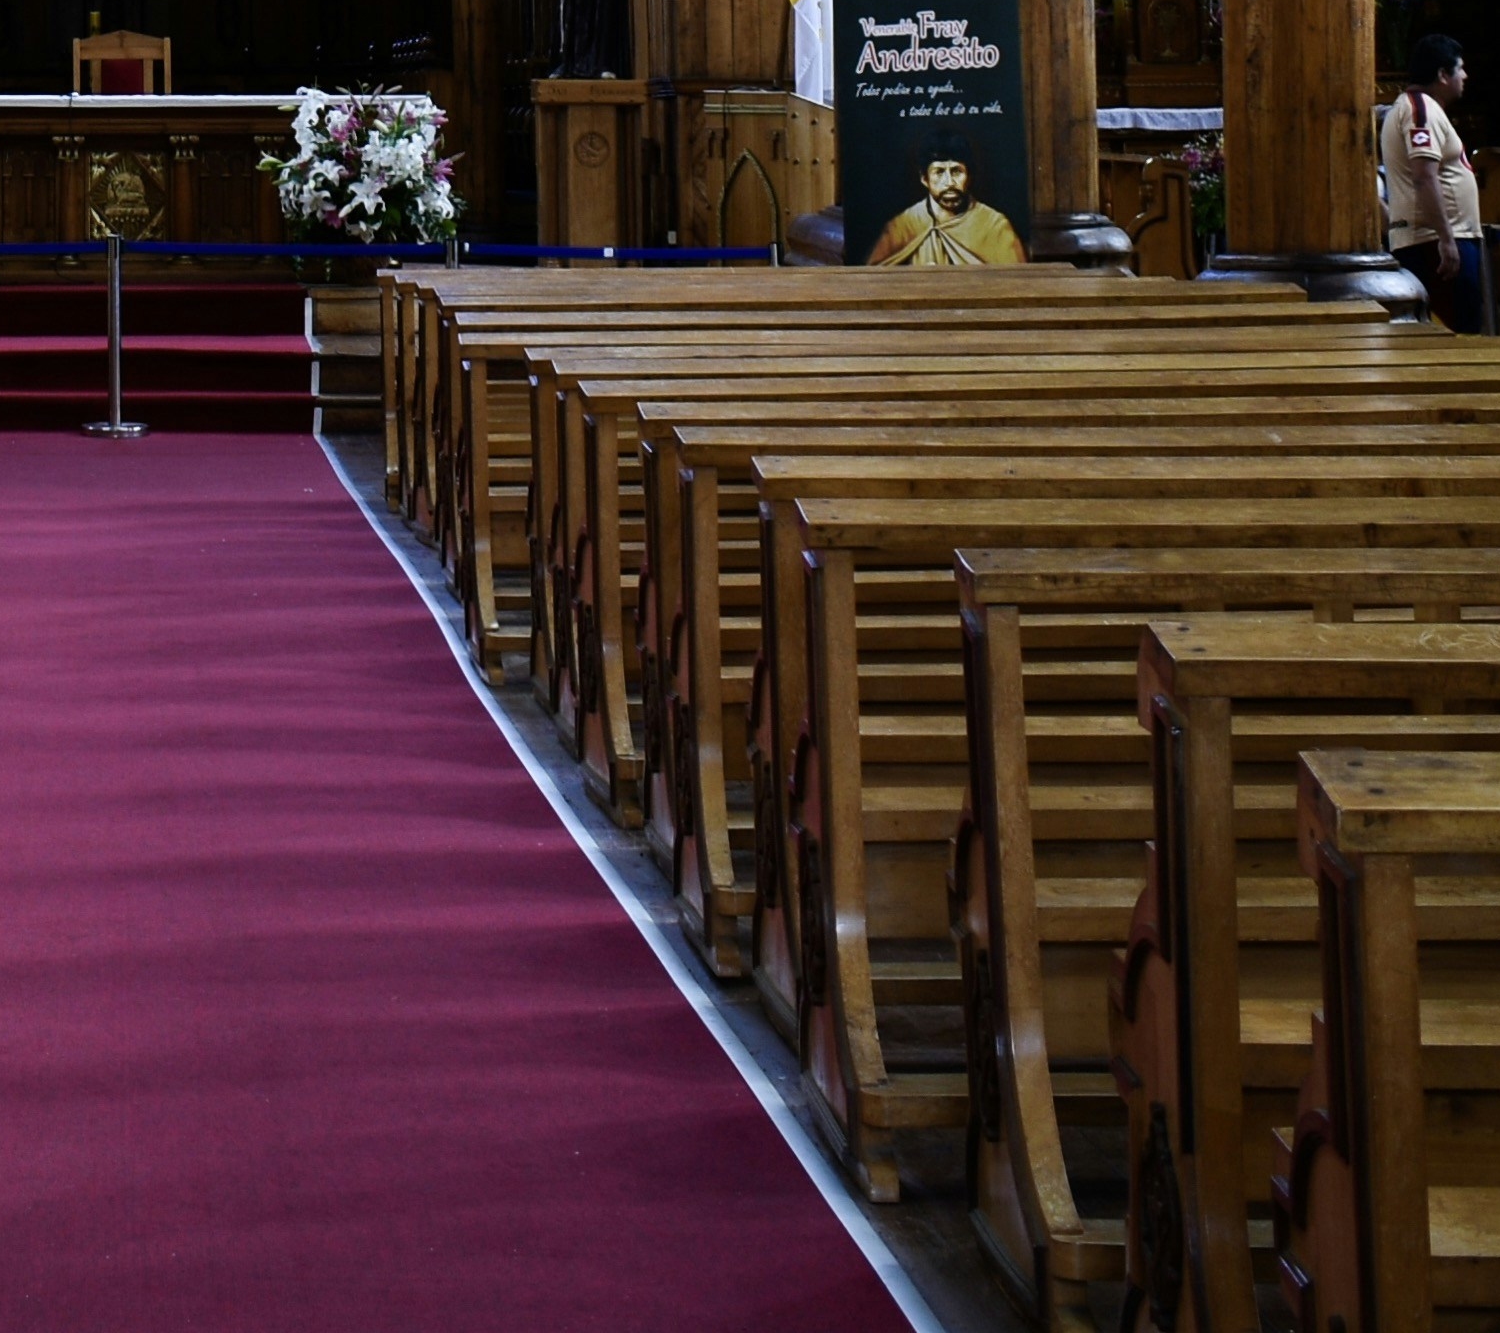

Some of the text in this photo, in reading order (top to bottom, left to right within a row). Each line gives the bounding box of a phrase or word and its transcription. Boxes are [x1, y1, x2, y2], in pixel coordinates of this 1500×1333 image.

[858, 10, 968, 45] Venerable Fray
[855, 34, 1000, 74] Andresito
[855, 82, 881, 97] Todos
[909, 103, 932, 116] todos
[935, 101, 951, 116] los
